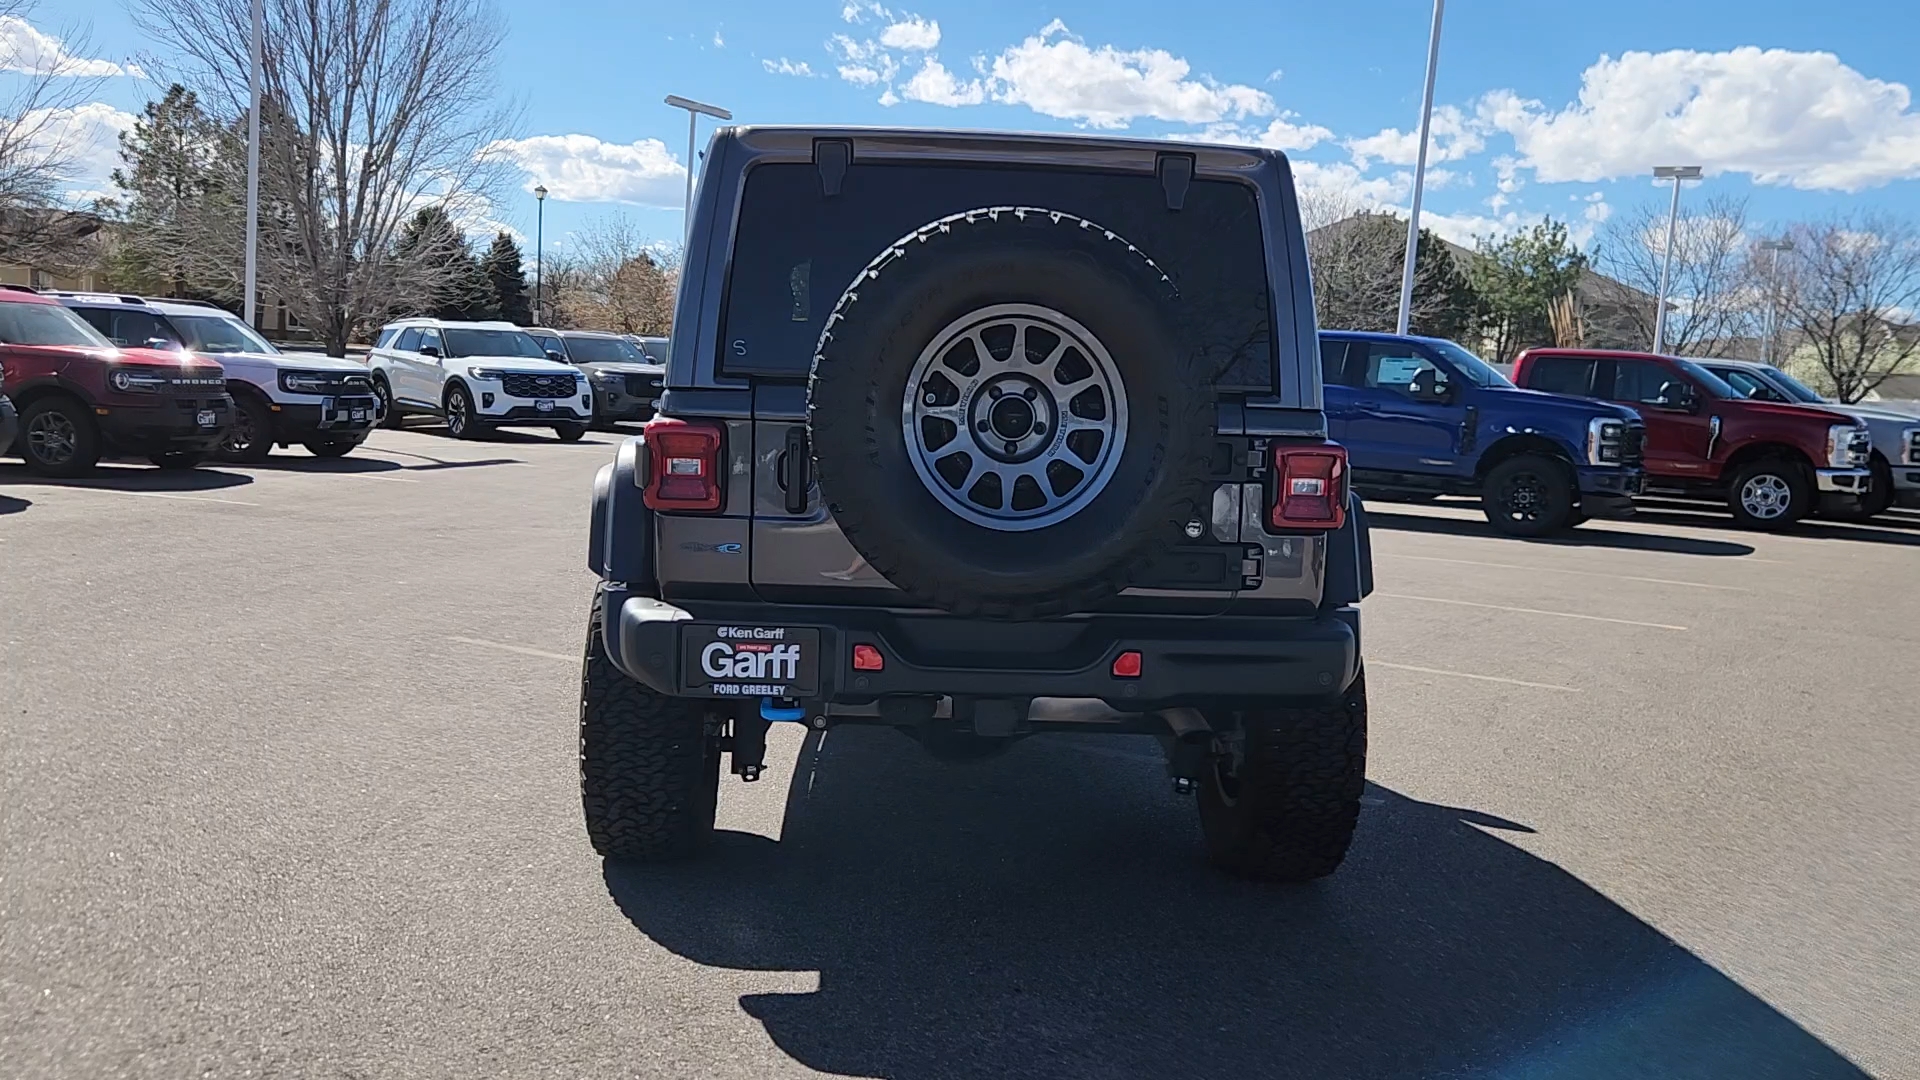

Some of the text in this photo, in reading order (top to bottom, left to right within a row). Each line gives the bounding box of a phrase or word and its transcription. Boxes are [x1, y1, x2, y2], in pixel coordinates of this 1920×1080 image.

[197, 413, 216, 424] Garff
[728, 627, 785, 639] Ken Garff
[701, 642, 800, 679] Garff
[713, 683, 786, 696] FORD GREELEY
